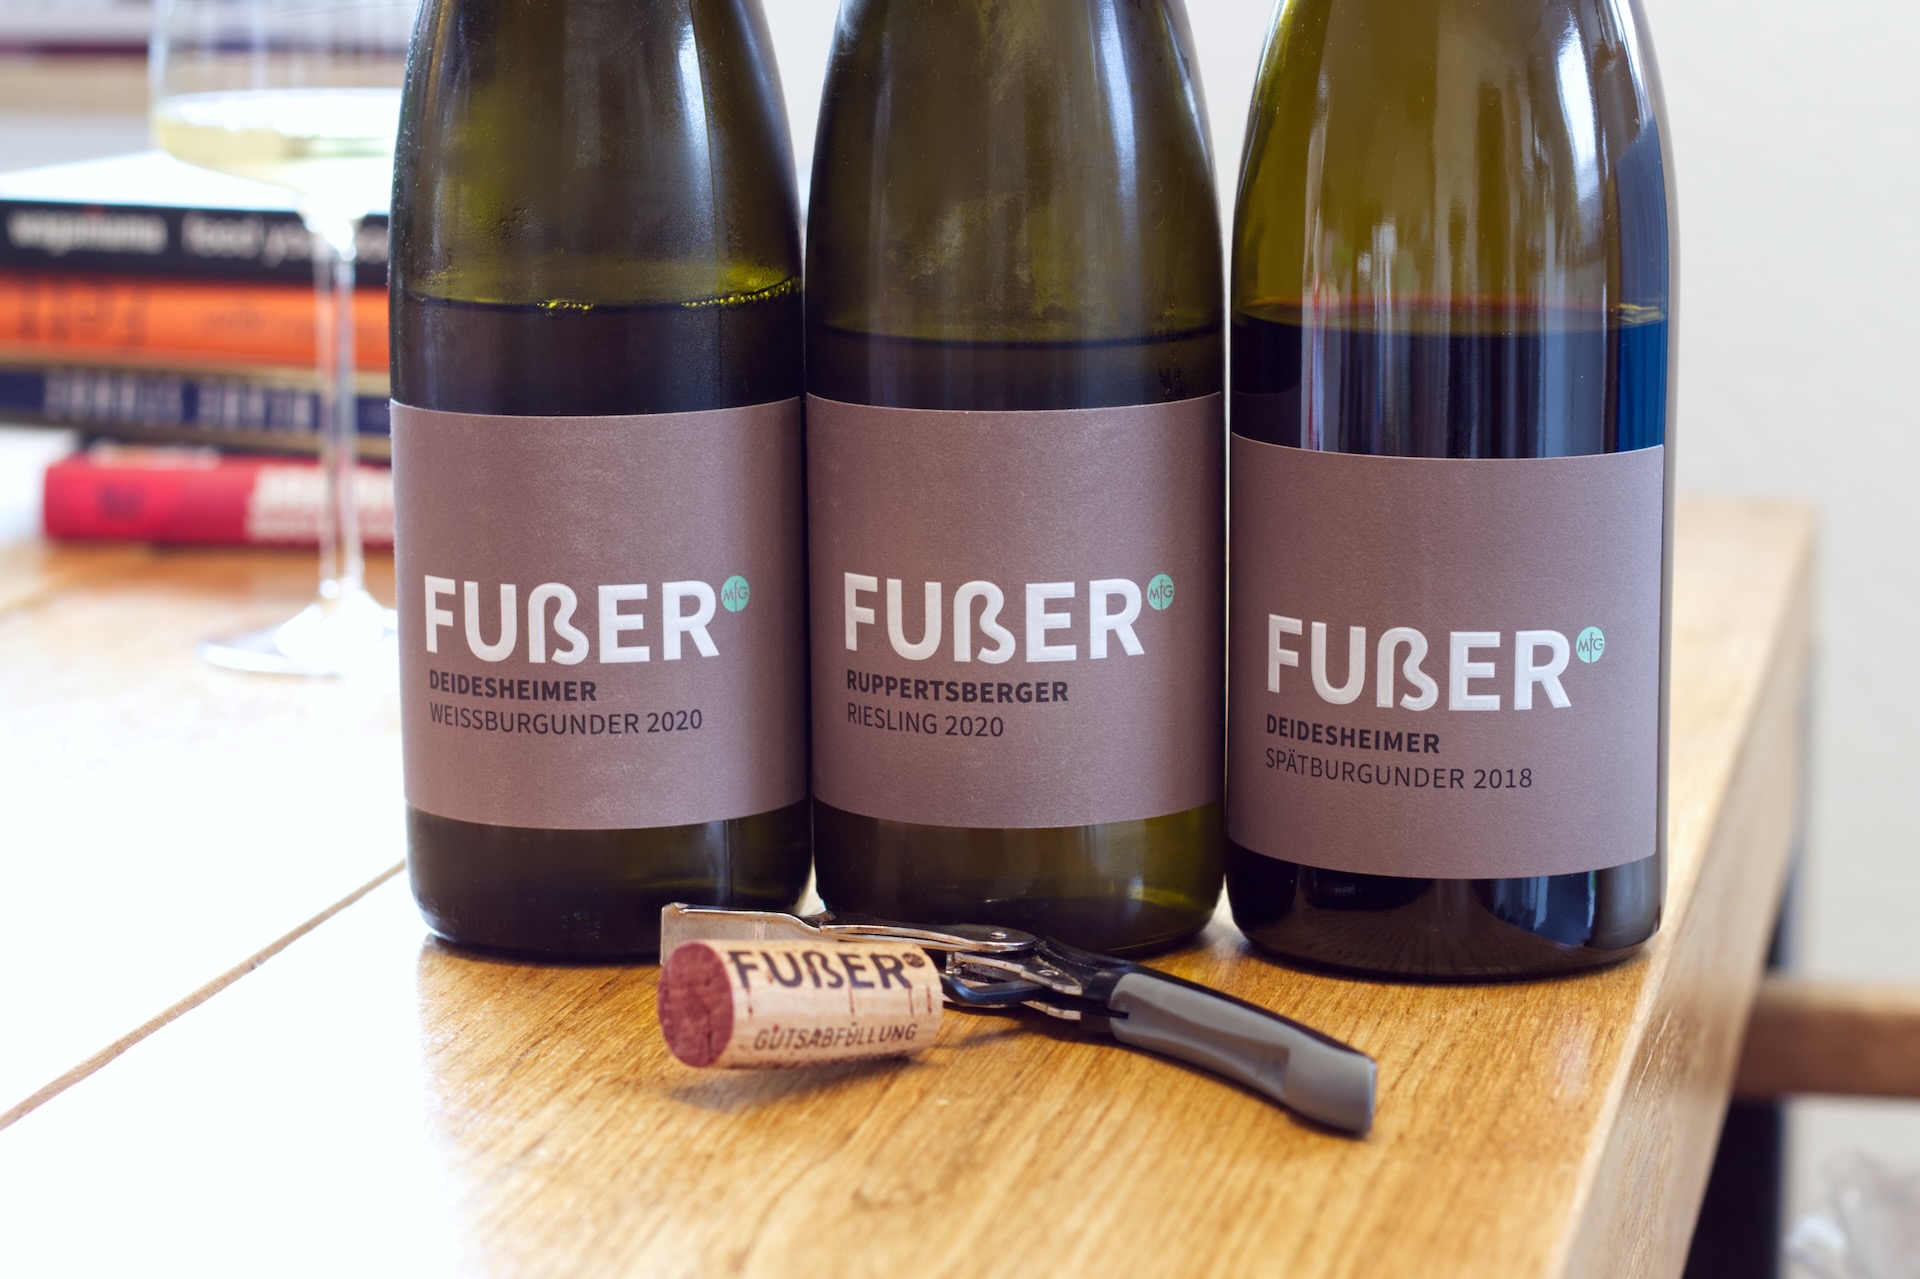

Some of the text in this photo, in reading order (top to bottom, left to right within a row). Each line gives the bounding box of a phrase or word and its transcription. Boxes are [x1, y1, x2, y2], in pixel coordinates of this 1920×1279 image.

[424, 574, 720, 665] FUßER
[844, 572, 1145, 664] FUßER
[1267, 613, 1572, 711] FUßER
[429, 669, 597, 701] DEIDESHEIMER
[846, 669, 1069, 703] RUPPERTSBERGER
[429, 701, 703, 735] WEISSBURGUNDER 2020
[847, 702, 1004, 737] RIESLING 2020
[1266, 713, 1440, 753] DEIDESHEIMER
[1265, 747, 1533, 789] SPÄTBURGUNDER 2018
[728, 950, 913, 990] FUßER
[754, 1022, 918, 1051] GUTSABFÜLLUNG
